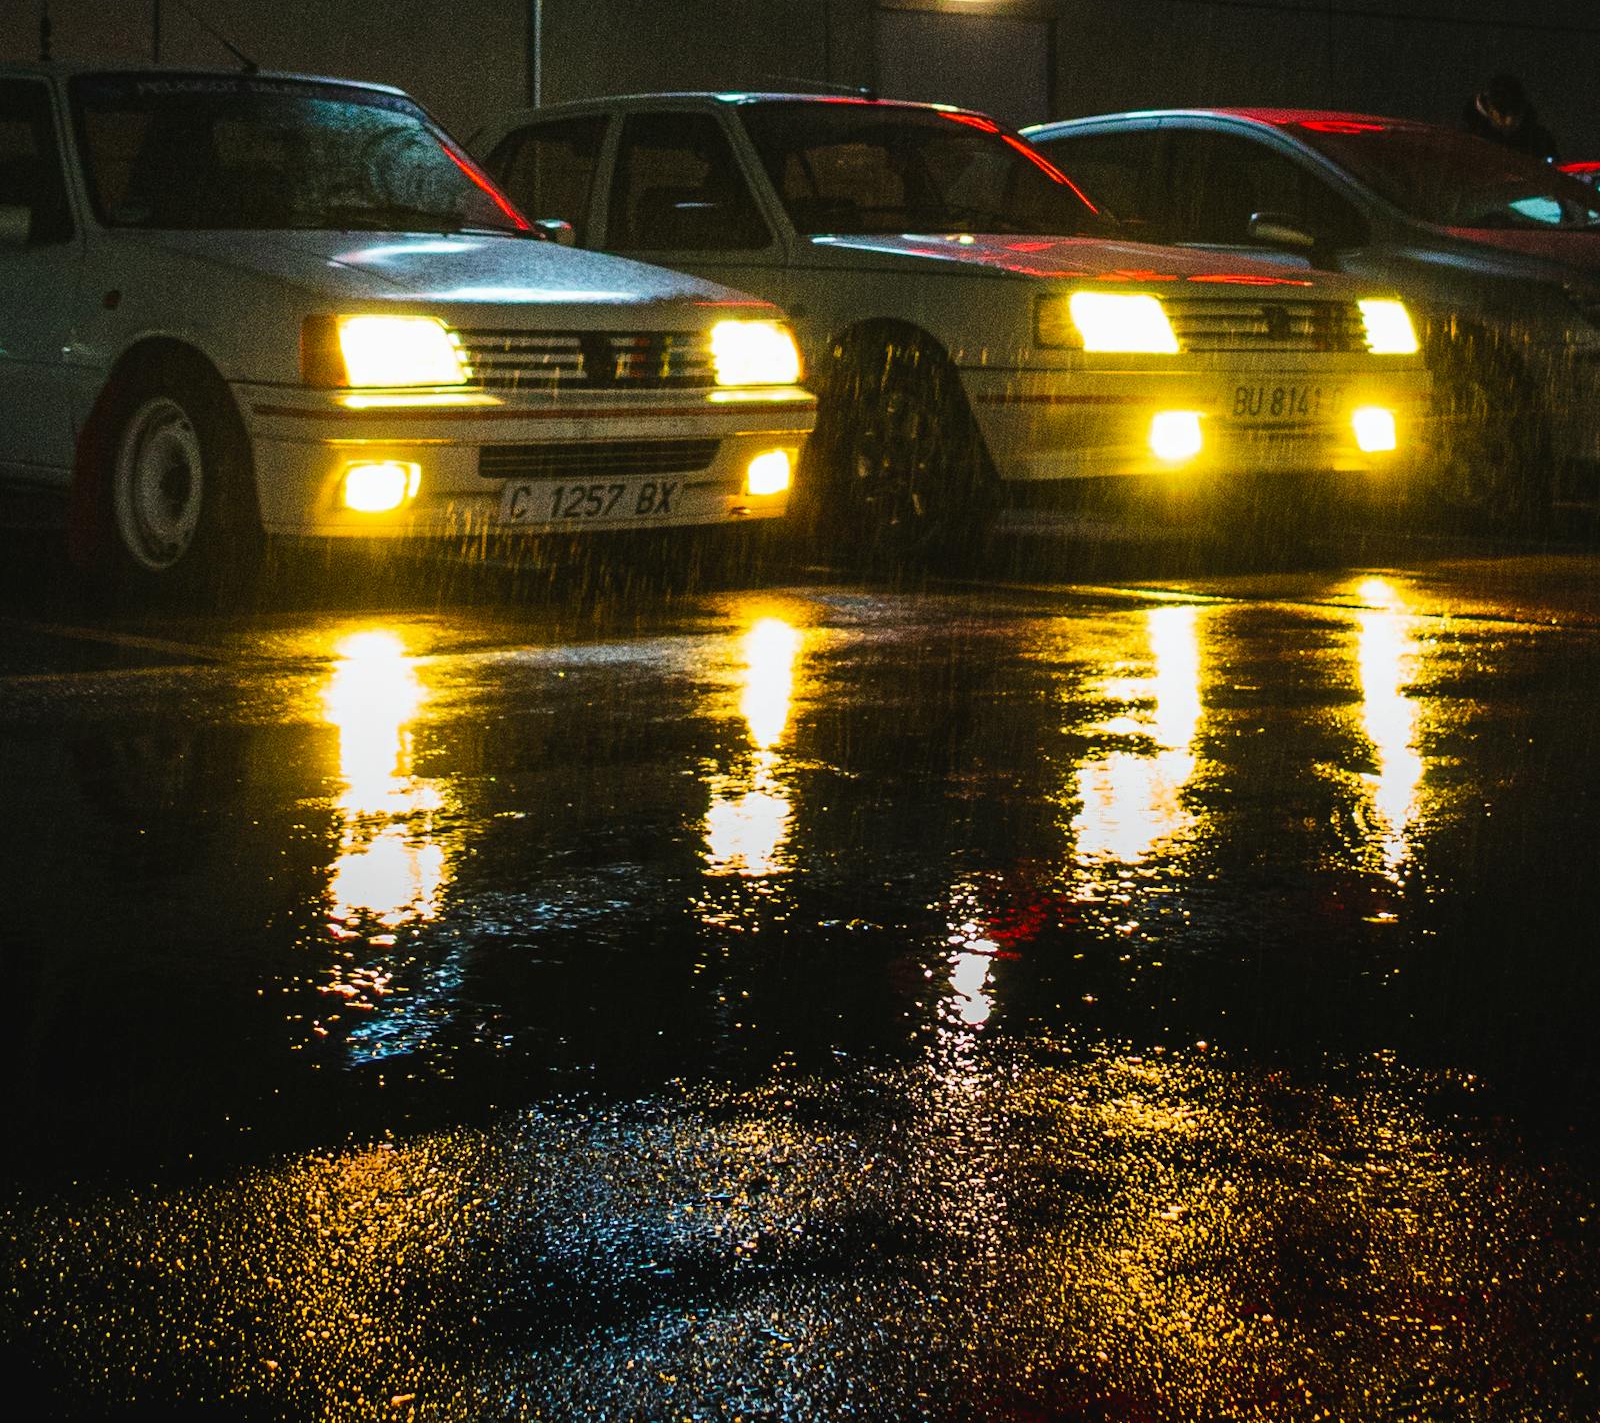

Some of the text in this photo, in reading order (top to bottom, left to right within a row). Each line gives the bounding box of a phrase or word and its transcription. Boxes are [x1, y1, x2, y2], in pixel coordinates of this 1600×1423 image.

[1232, 386, 1264, 416] BU
[510, 481, 678, 520] C 1257 BX
